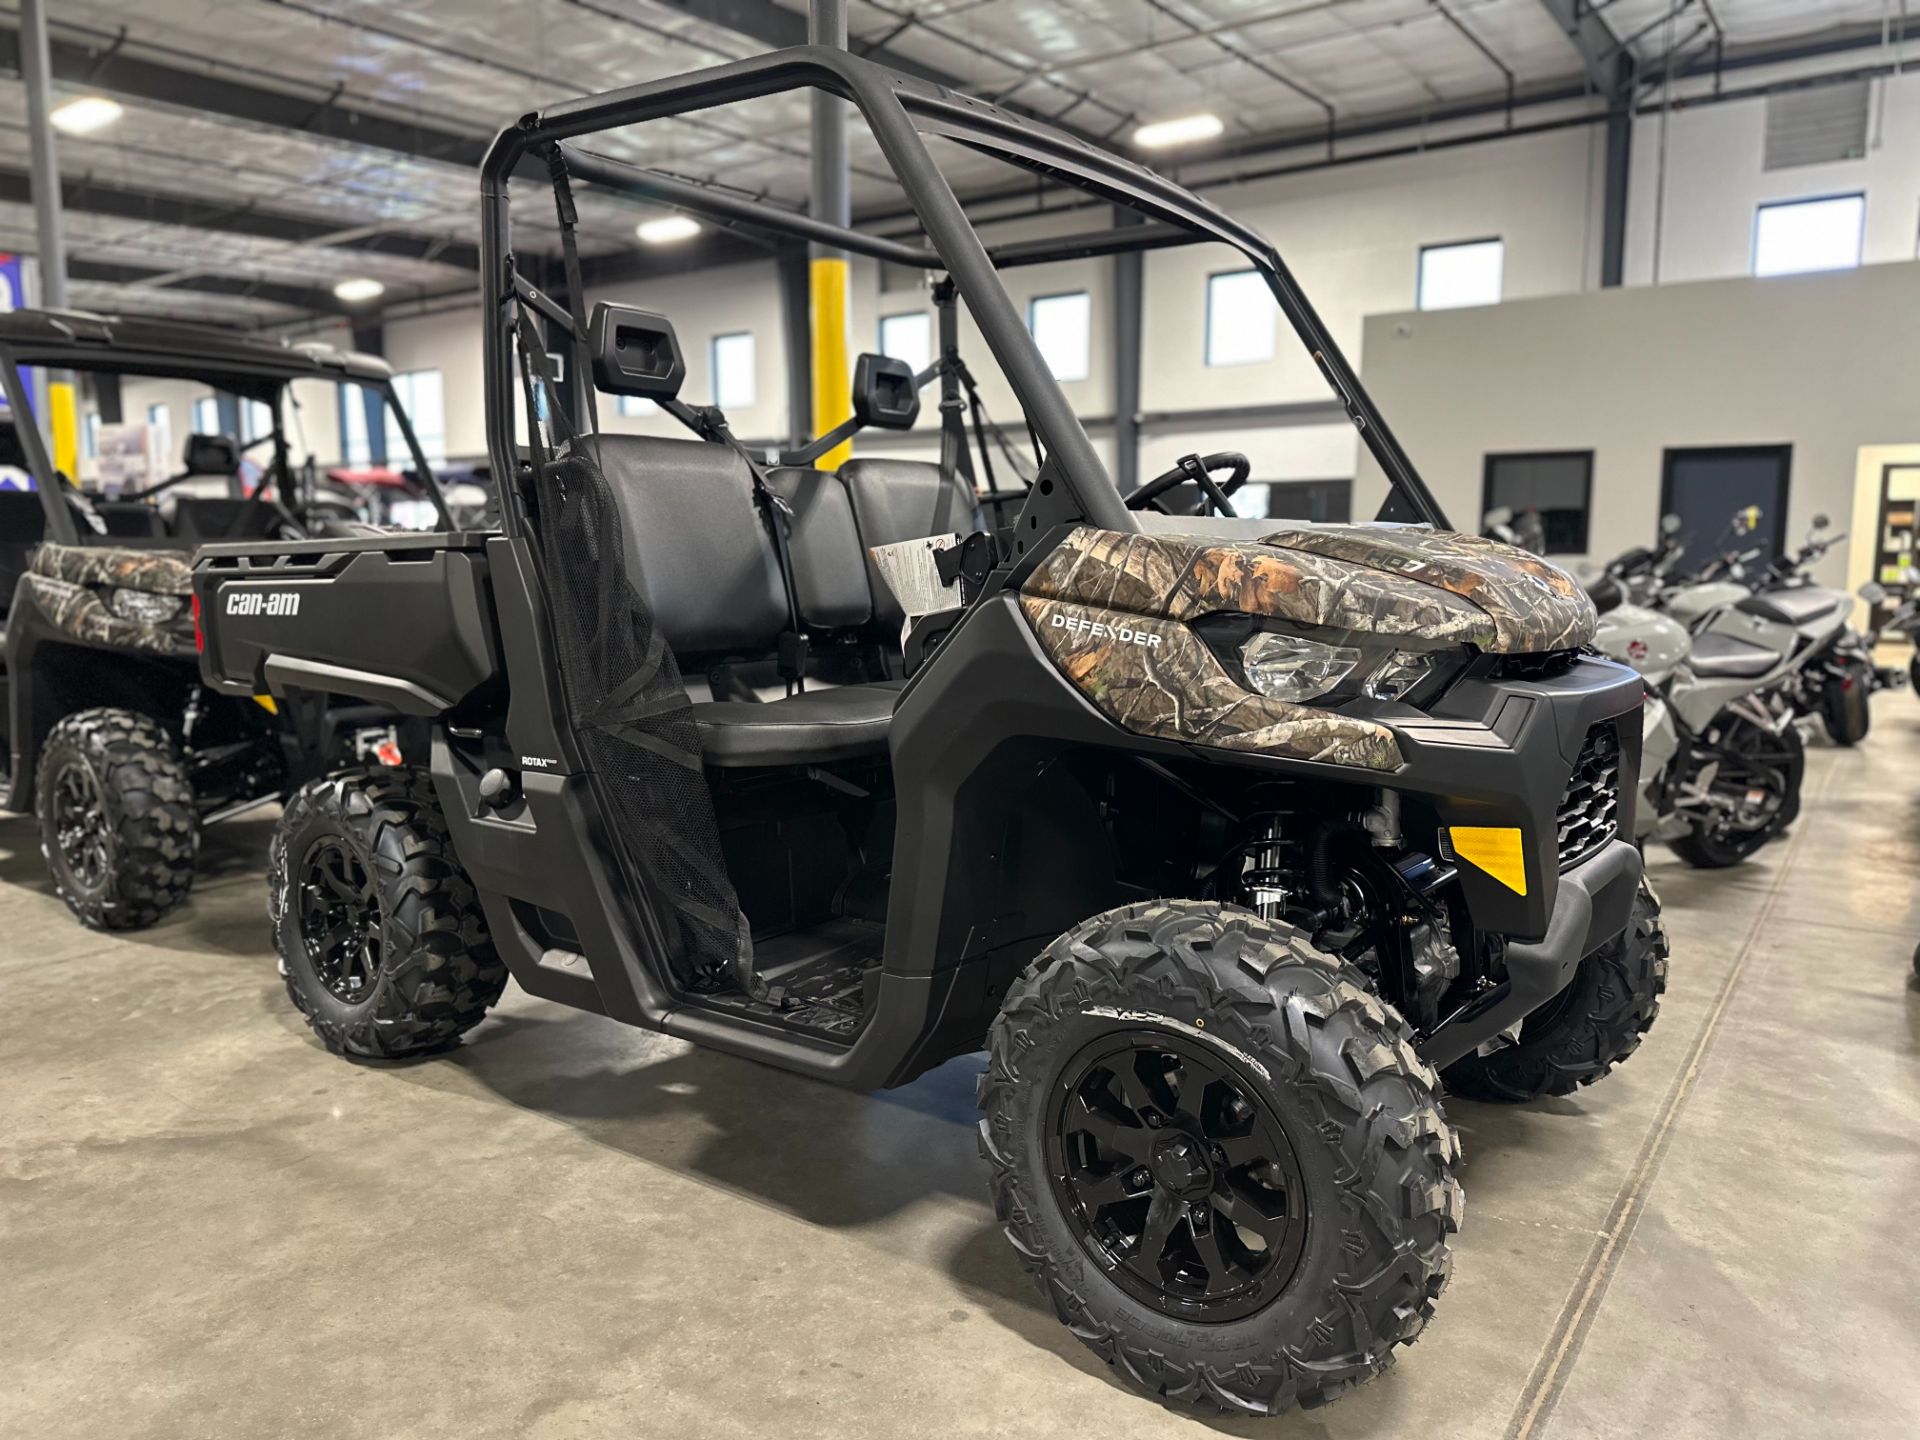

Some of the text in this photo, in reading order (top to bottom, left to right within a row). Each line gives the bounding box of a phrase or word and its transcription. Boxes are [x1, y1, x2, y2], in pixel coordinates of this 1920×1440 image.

[226, 592, 301, 616] can-am
[1051, 613, 1162, 649] DEFENDER
[521, 755, 548, 768] ROTAX
